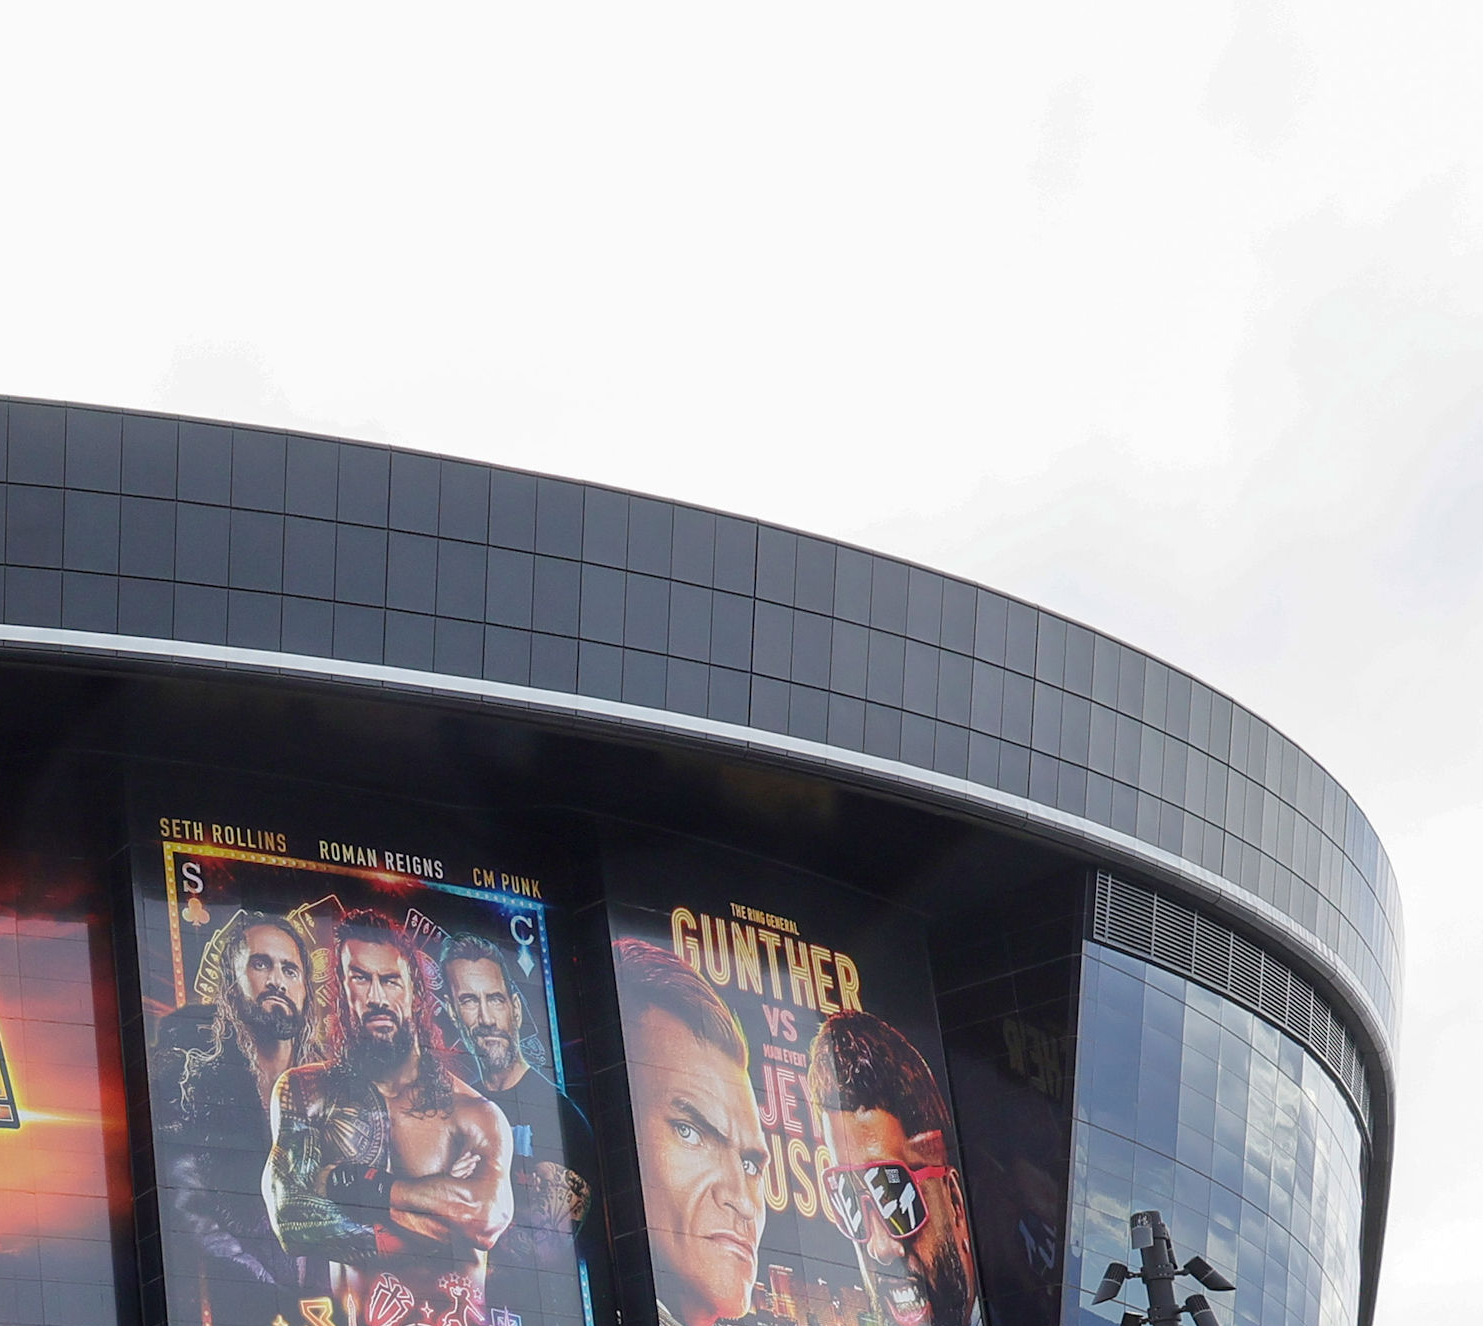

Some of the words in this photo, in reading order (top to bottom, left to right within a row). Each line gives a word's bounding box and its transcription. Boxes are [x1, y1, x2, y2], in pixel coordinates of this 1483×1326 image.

[160, 817, 204, 842] SETH
[212, 824, 287, 853] ROLLINS
[181, 861, 205, 894] S
[319, 840, 378, 869] ROMAN
[384, 851, 444, 880] REIGNS
[473, 867, 496, 889] CM
[501, 872, 543, 899] PUNK
[510, 914, 536, 946] C
[730, 902, 746, 919] THE
[746, 908, 766, 926] RING
[766, 913, 800, 936] GENERAL
[671, 907, 863, 1015] GUNTHER
[762, 1004, 798, 1042] VS
